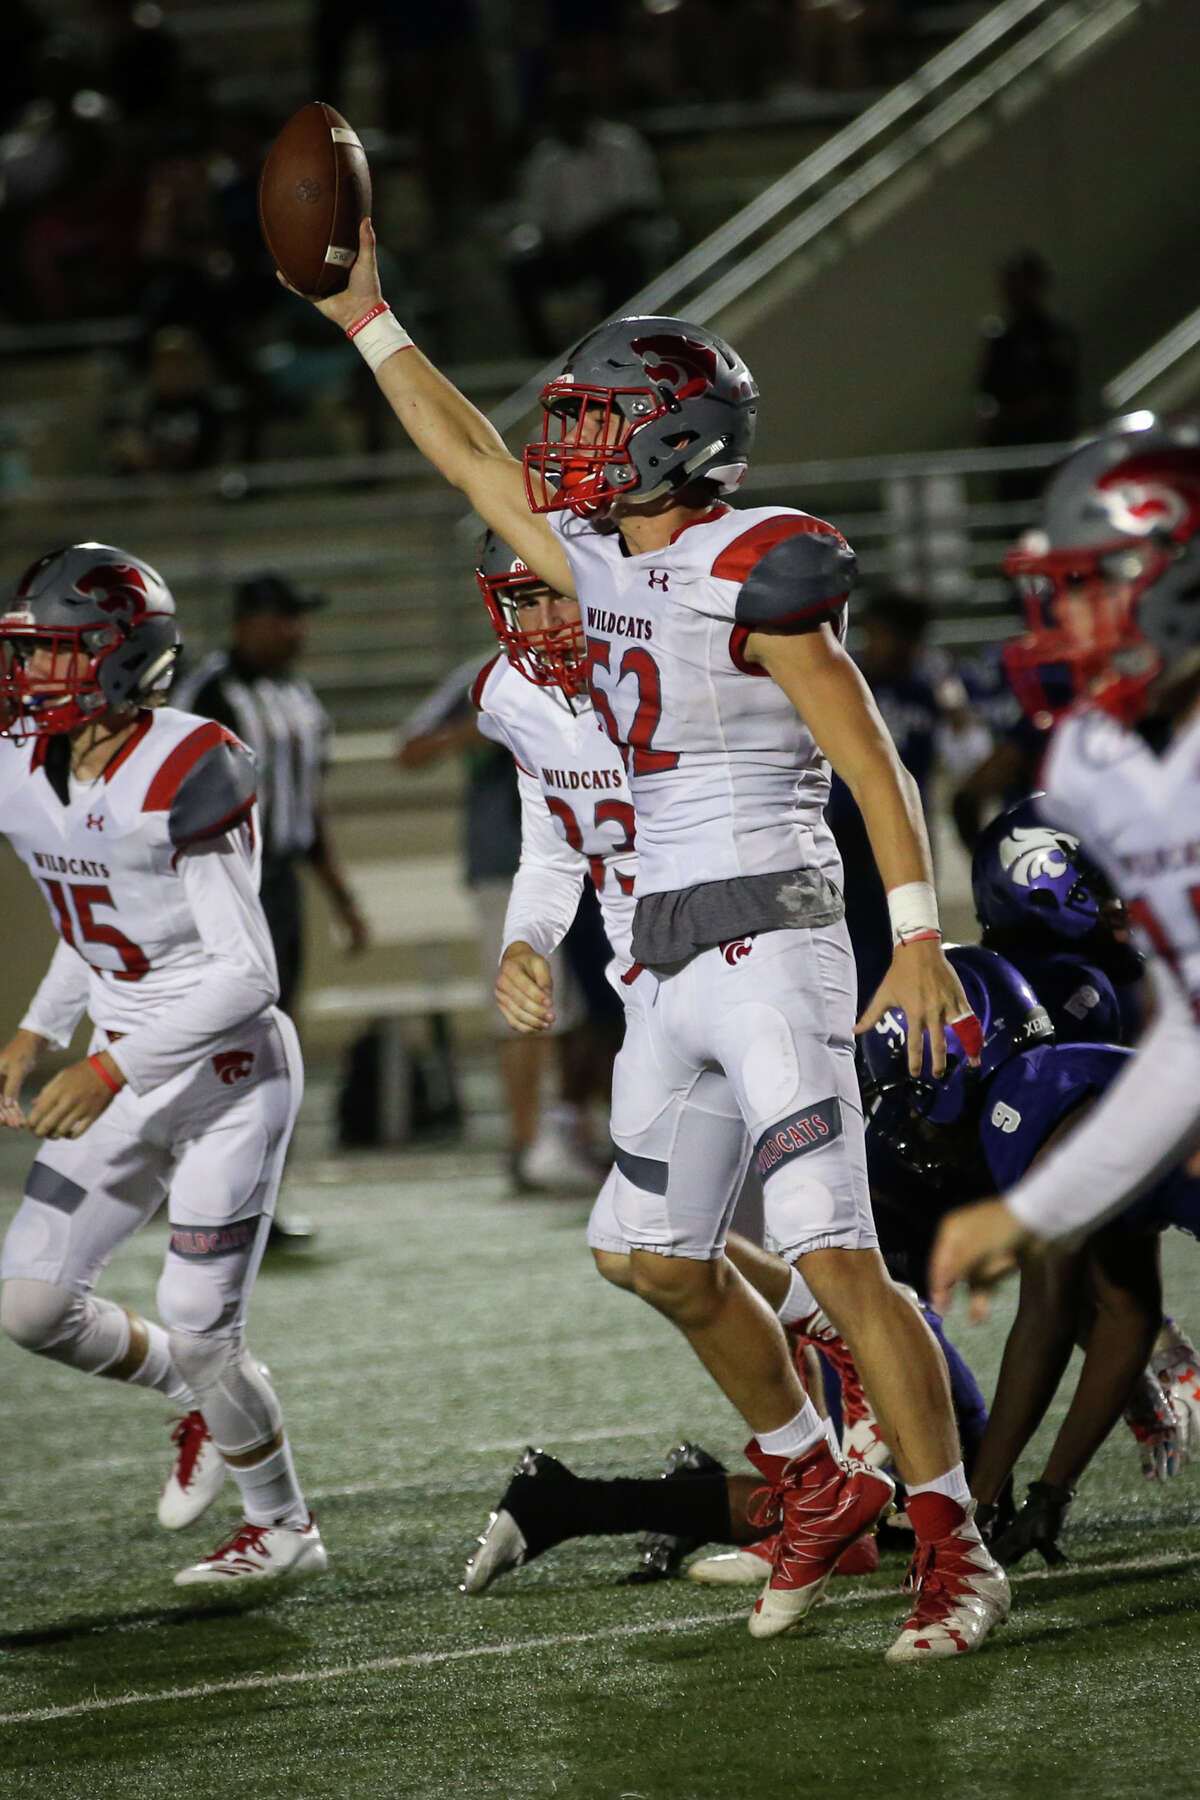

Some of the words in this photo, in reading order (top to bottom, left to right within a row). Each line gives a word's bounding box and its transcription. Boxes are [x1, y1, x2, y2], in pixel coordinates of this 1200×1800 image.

[587, 606, 653, 640] WILDCATS
[586, 635, 681, 778] 52
[541, 767, 622, 790] WILDCATS
[32, 851, 110, 879] WILDCATS
[40, 877, 151, 983] 15
[992, 1100, 1021, 1133] 9
[758, 1114, 830, 1175] WILDCATS
